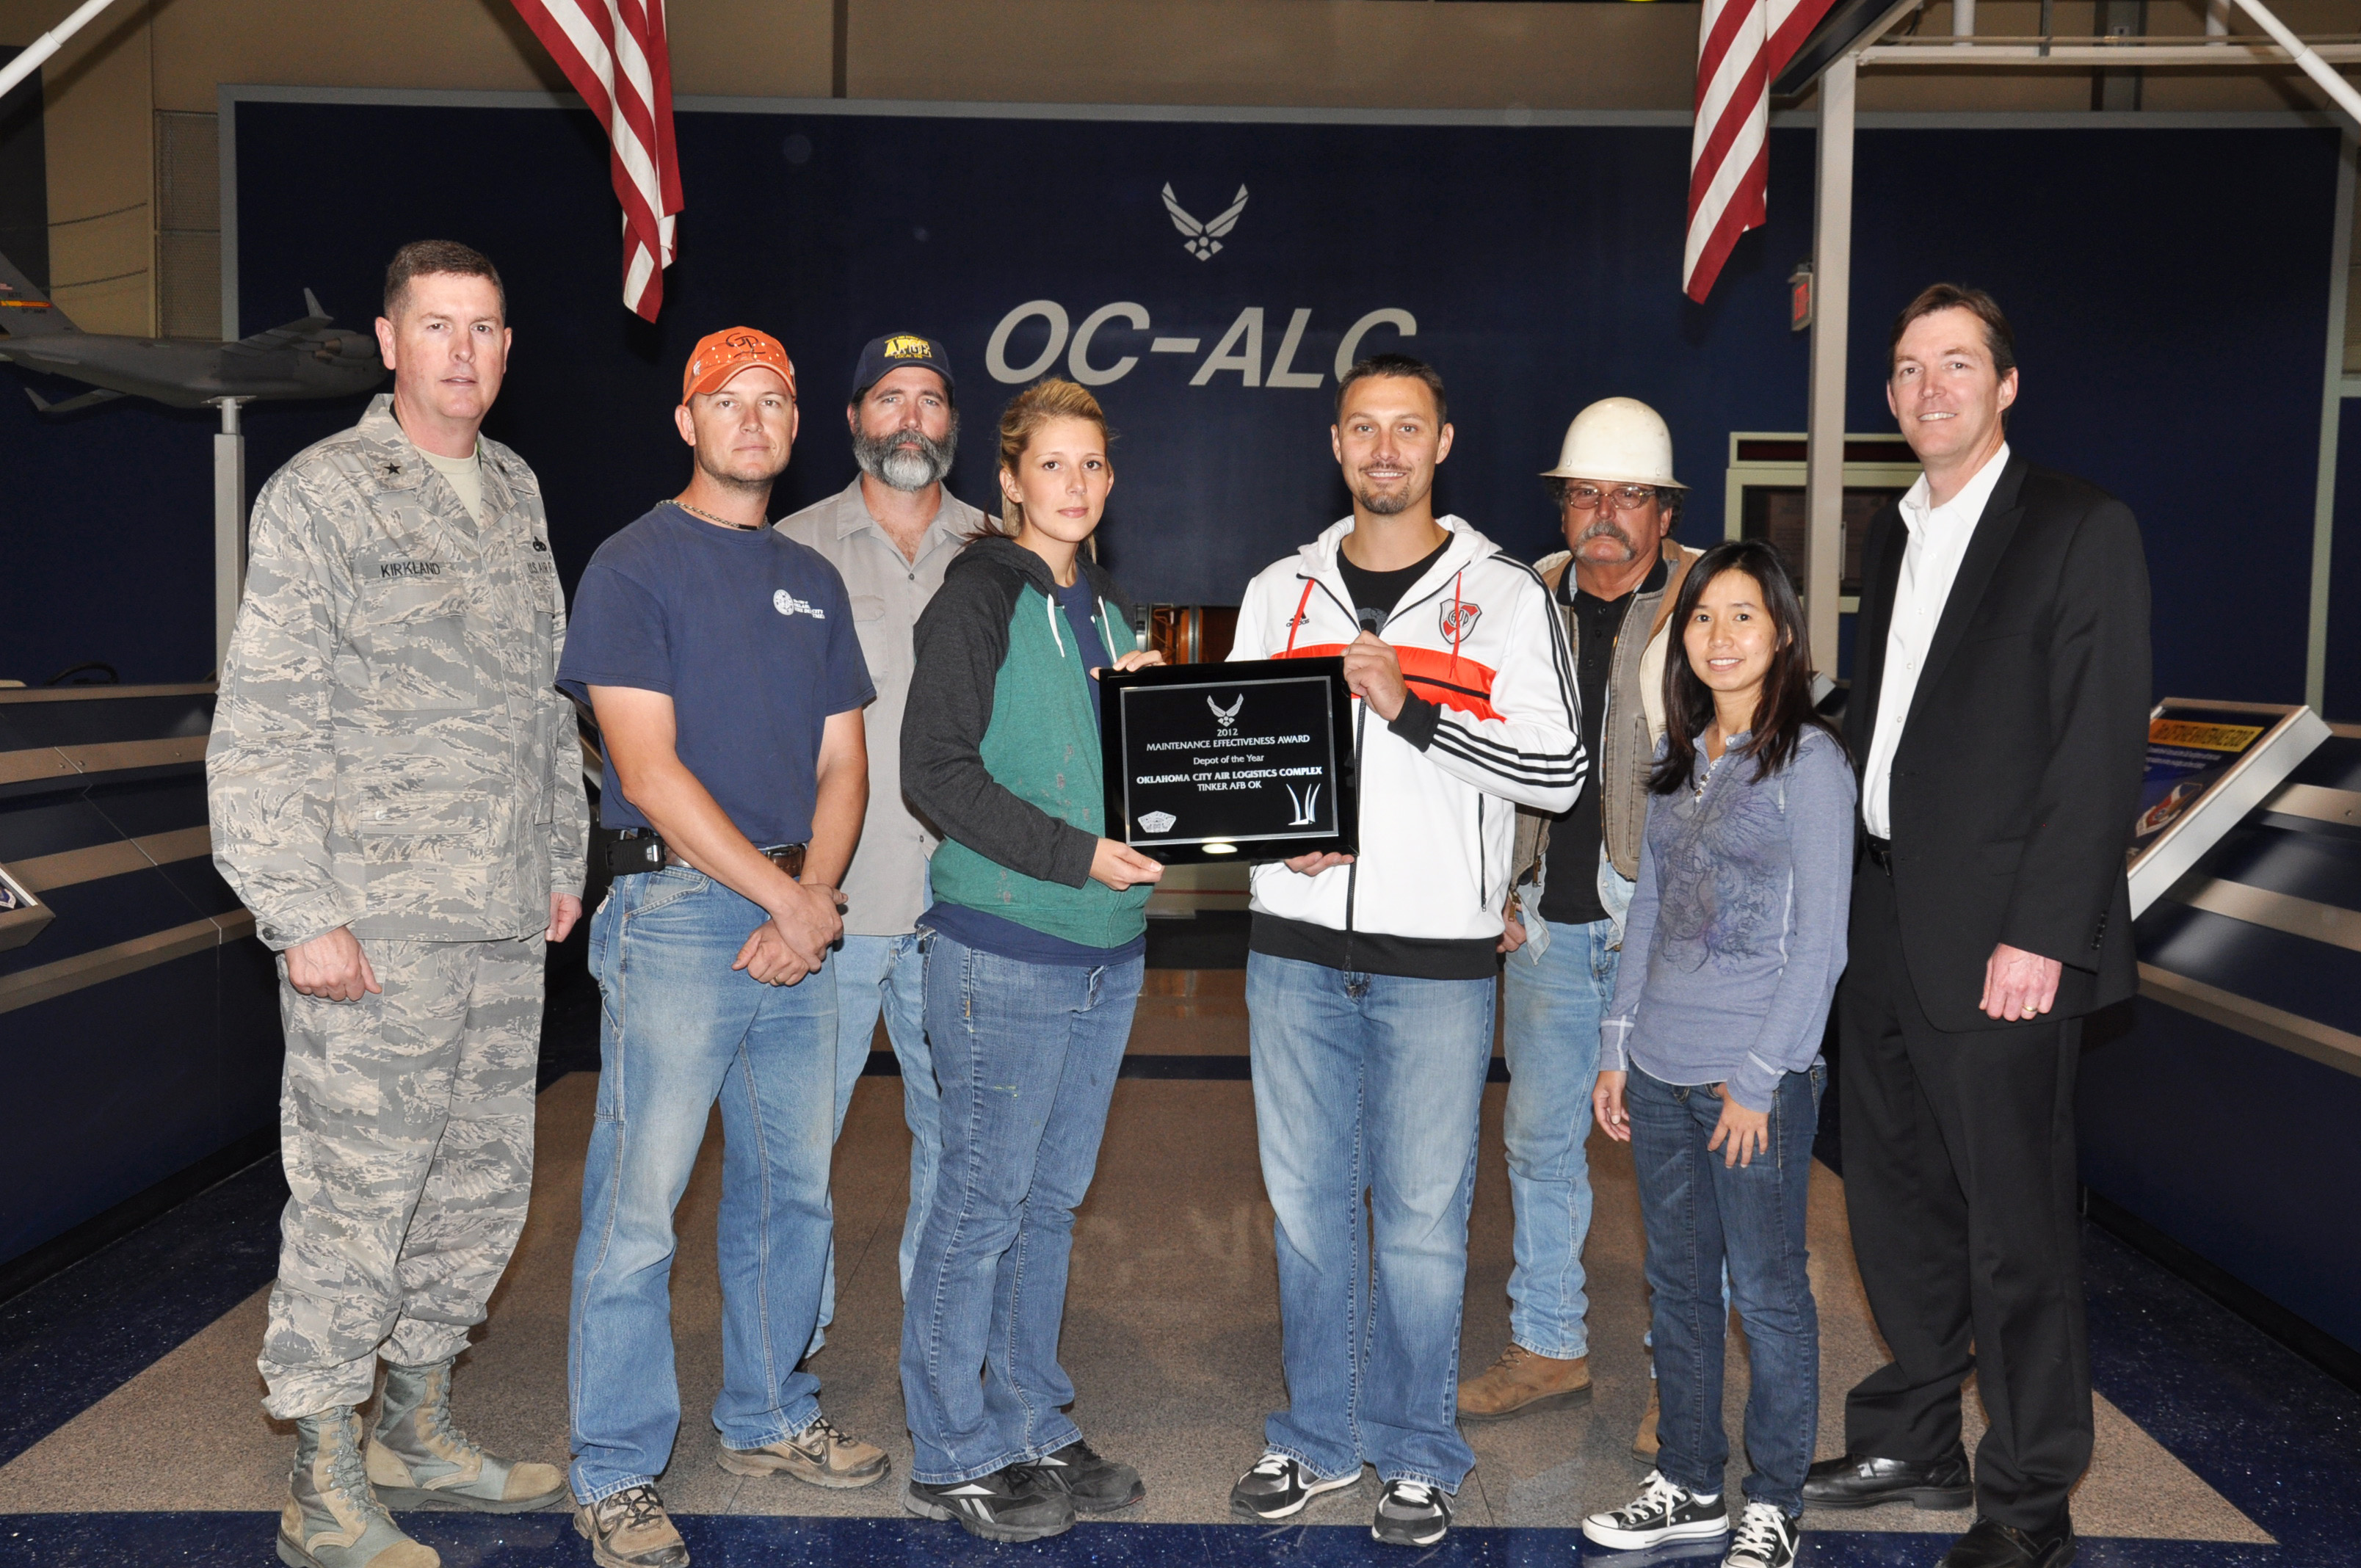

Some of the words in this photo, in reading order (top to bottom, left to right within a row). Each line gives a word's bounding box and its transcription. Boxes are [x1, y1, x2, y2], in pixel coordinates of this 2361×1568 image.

[884, 338, 932, 357] AFGE
[985, 299, 1418, 388] OC-ALC
[380, 561, 440, 578] KIRKLAND
[537, 562, 549, 573] AIR
[1285, 618, 1310, 627] adas
[1216, 728, 1238, 737] 2012
[1146, 740, 1211, 751] MAINTENANCE
[1213, 736, 1276, 748] EFFECTIVENESS
[1277, 735, 1310, 744] AWARD
[1193, 757, 1219, 766] Depot
[1220, 755, 1230, 763] of
[1231, 755, 1245, 763] the
[1246, 754, 1264, 762] Year
[1136, 774, 1191, 784] OKLAHOMA
[1192, 772, 1212, 781] CITY
[1214, 772, 1230, 780] AIR
[1232, 769, 1277, 780] LOGISTICS
[1279, 766, 1322, 777] COMPLEX
[1197, 782, 1229, 791] TINKER
[1229, 781, 1247, 790] AFB
[1248, 780, 1262, 789] OK
